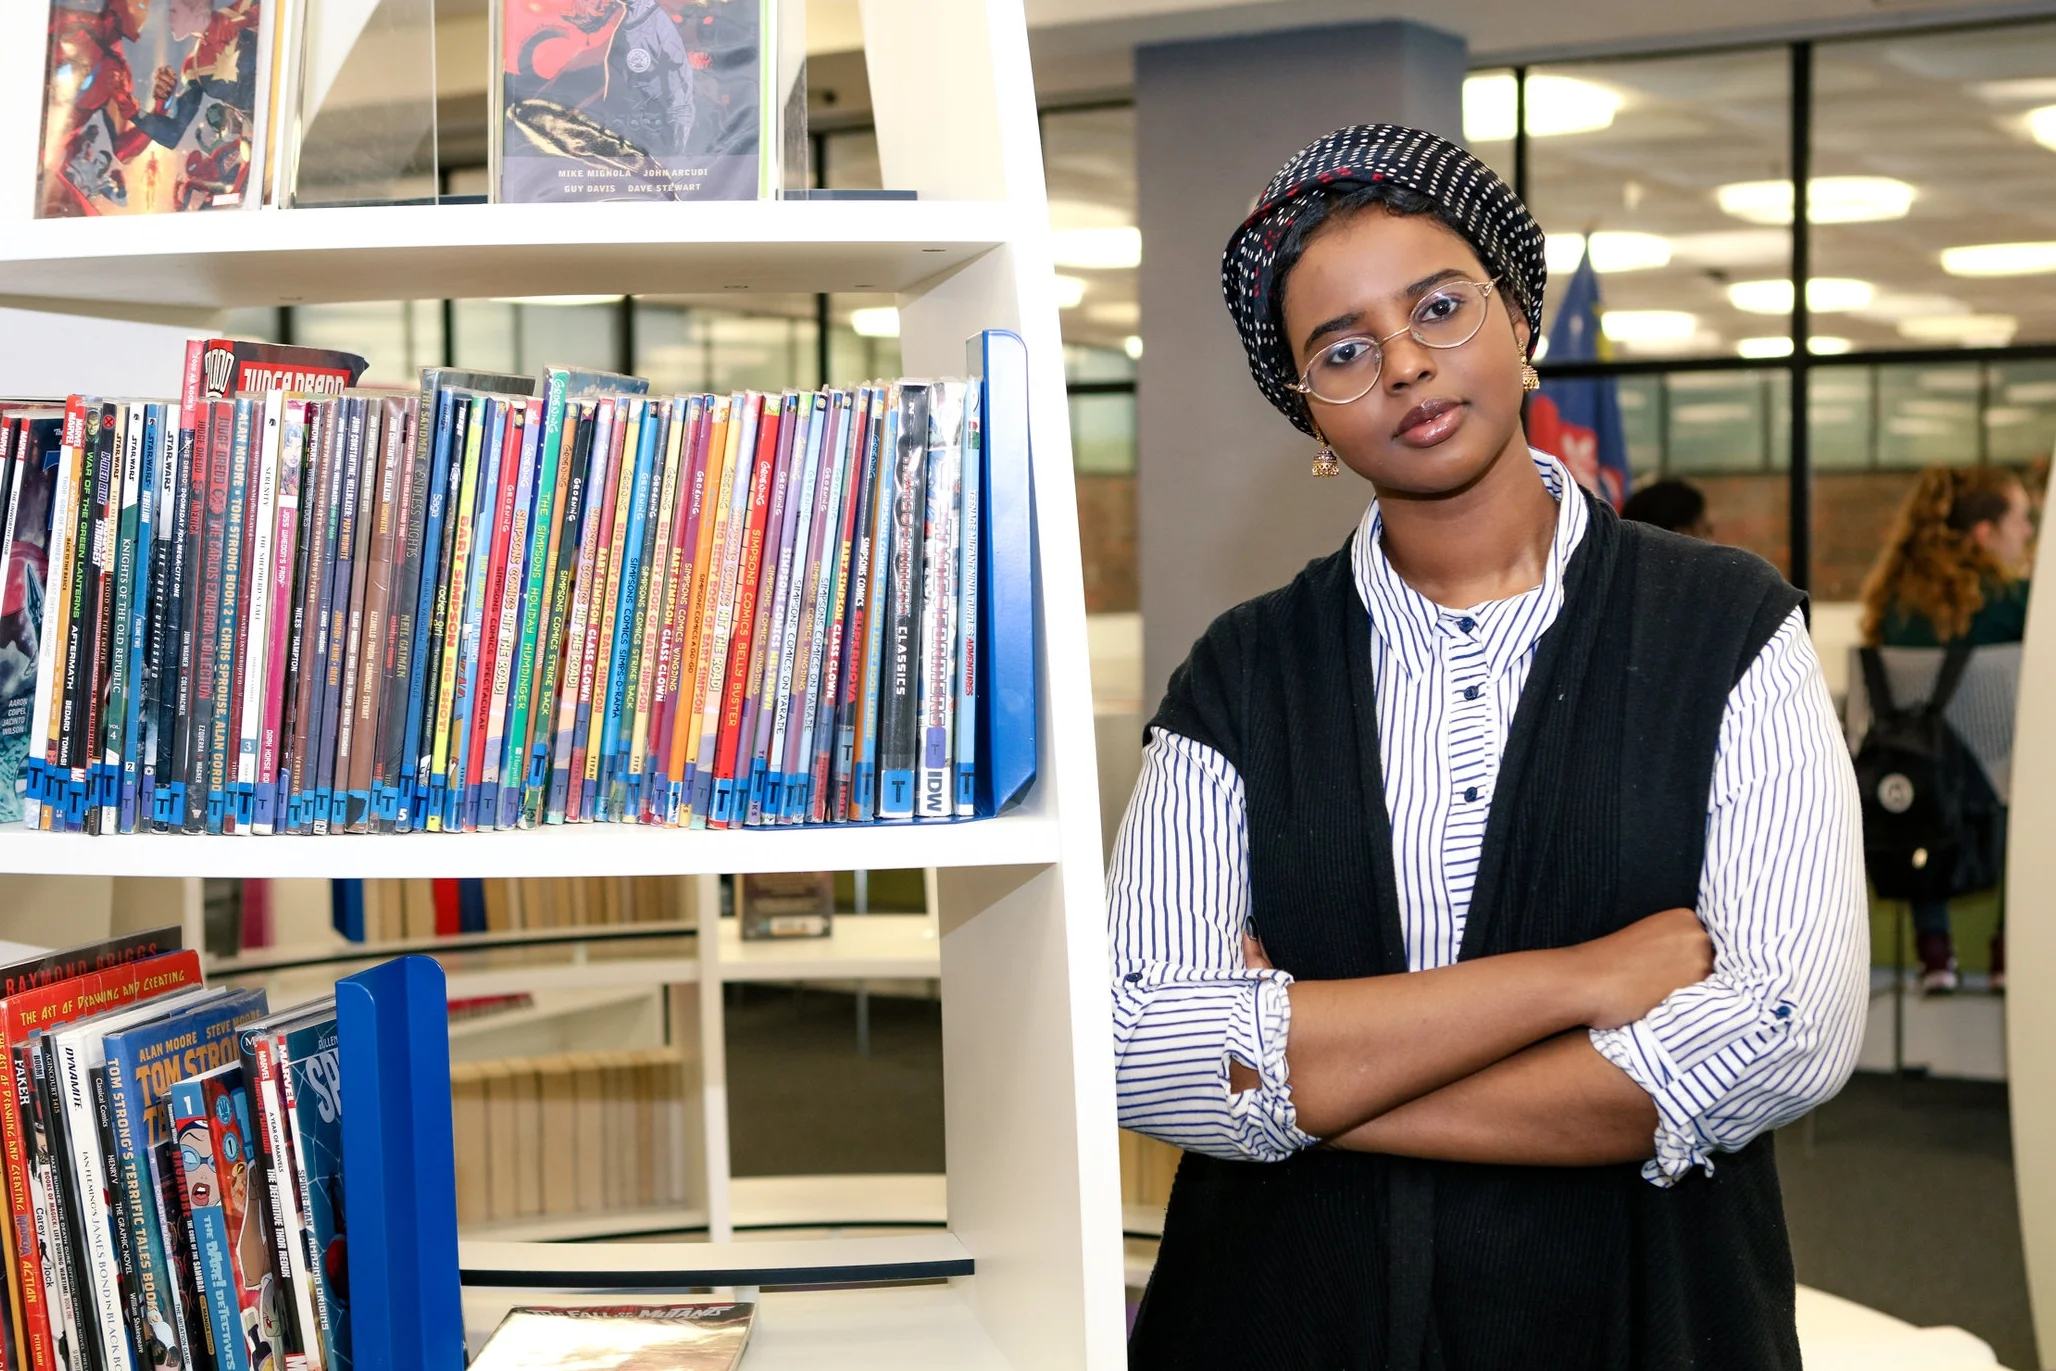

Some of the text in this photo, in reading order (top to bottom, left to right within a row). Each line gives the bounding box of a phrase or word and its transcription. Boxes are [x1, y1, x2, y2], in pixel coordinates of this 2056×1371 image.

[564, 185, 584, 193] GUY
[628, 184, 652, 192] DAVE
[656, 184, 701, 192] STEWART
[587, 169, 631, 177] MIGNOLA
[644, 169, 668, 177] JOHN
[18, 430, 27, 460] MARVEL
[66, 412, 76, 445] MARVEL
[73, 418, 83, 447] MARVEL
[195, 420, 205, 473] JUDGE DREDD
[236, 412, 248, 442] ALAN
[417, 411, 430, 460] SANDMAN
[214, 416, 230, 484] JUDGE DREDD
[233, 445, 247, 486] MOORE
[84, 480, 91, 494] OF
[97, 451, 110, 505] X-MEN BLUE
[263, 466, 272, 506] SERENITY
[568, 478, 581, 522] GROENING
[7, 503, 16, 538] UNWORTHY
[141, 490, 151, 522] REBELLION
[189, 500, 200, 534] AMERICA
[229, 499, 242, 523] TOM
[407, 470, 426, 558] ENDLESS NIGHTS
[430, 494, 443, 518] Saga
[502, 484, 514, 532] GROENING
[78, 522, 88, 558] GREEN
[226, 526, 239, 571] STRONG
[73, 561, 85, 617] LANTERNS
[224, 574, 237, 606] BOOK
[434, 585, 447, 637] rocket girl
[494, 509, 526, 695] SIMPSONS COMICS HIT THE ROAD!
[517, 492, 550, 709] THE SIMPSONS HOLIDAY HUMDINGER
[112, 539, 130, 693] KNIGHTS OF THE OLD REPUBLIC
[199, 540, 222, 699] CARLOS EZQUERRA COLLECTION
[438, 516, 469, 733] BART SIMPSON BIG SHOT!
[612, 557, 638, 718] SIMPSONS COMICS SIMPS-O-RAMA
[728, 529, 761, 726] SIMPSONS COMICS BELLY BUSTER
[848, 537, 870, 704] SIMPSONS COMICS SUPERNOVA
[930, 519, 952, 726] TRANSFORMERS
[67, 625, 78, 689] AFTERMATH
[220, 627, 232, 660] CHRIS
[397, 615, 410, 677] NEIL GAIMAN
[478, 566, 504, 730] SIMPSONS COMICS SPECTACULAR
[896, 626, 908, 695] CLASSICS
[965, 637, 974, 696] ADVENTURES
[63, 700, 72, 731] BEDARD
[892, 780, 905, 803] T
[927, 771, 942, 812] IDW
[21, 1010, 37, 1026] THE
[41, 1005, 56, 1020] ART
[77, 987, 119, 1009] DRAWING
[123, 982, 140, 996] AND
[143, 970, 184, 991] CREATING
[139, 1022, 230, 1062] ALAN MOORE STEVE
[14, 1060, 30, 1105] FAKER
[45, 1053, 60, 1113] AGINCOURT 1415
[65, 1047, 82, 1109] DYNAMITE
[108, 1058, 120, 1088] TOM
[136, 1057, 182, 1105] TOM
[259, 1051, 269, 1080] MARVEL
[279, 1045, 294, 1104] MARVEL
[3, 1090, 16, 1137] DRAWING
[95, 1078, 108, 1127] Classical Comics
[184, 1096, 192, 1115] 1
[114, 1093, 136, 1160] STRONG'S
[9, 1141, 18, 1160] AND
[107, 1155, 116, 1178] HENRY
[11, 1165, 25, 1211] CREATING
[128, 1163, 145, 1225] TERRIFIC
[269, 1185, 283, 1226] DEFINITIVE
[16, 1214, 32, 1256] MANGA
[36, 1207, 45, 1236] Carey
[49, 1202, 57, 1228] MAGICK:
[154, 1185, 172, 1254] SCHOLASTIC READERS
[55, 1243, 64, 1266] DURING
[117, 1218, 132, 1274] GRAPHIC NOVEL
[136, 1228, 150, 1268] TALES
[275, 1228, 291, 1278] THOR REDUX
[298, 1170, 329, 1331] SPIDER-MAN AMAZING ORIGINS
[59, 1267, 68, 1296] WARTIME:
[92, 1218, 118, 1353] JAMES BOND BLACK
[144, 1273, 159, 1312] BOOK
[193, 1261, 205, 1293] SAMURAI
[204, 1215, 236, 1370] THE DARE! DETECTIVES
[130, 1293, 144, 1354] William Shakespeare
[177, 1316, 187, 1346] IMITATION
